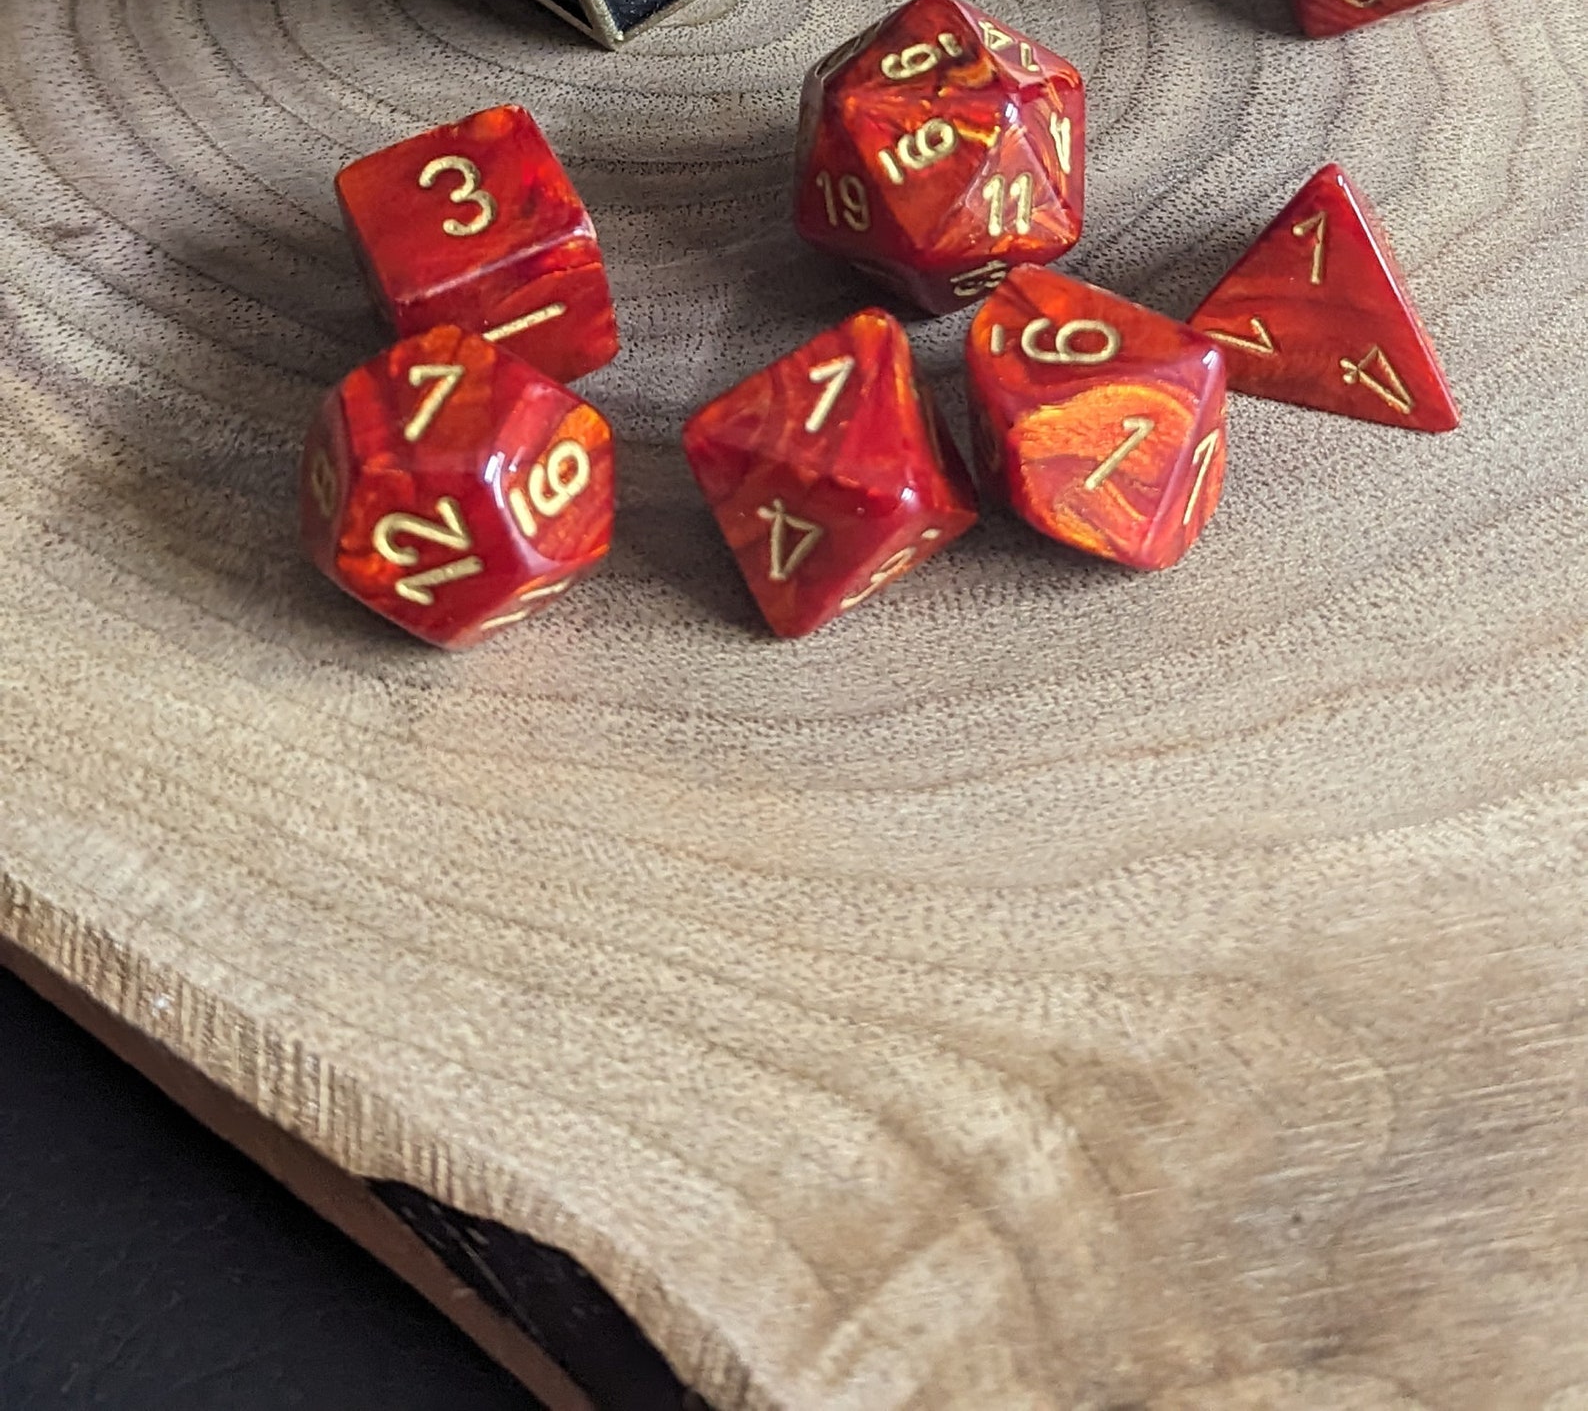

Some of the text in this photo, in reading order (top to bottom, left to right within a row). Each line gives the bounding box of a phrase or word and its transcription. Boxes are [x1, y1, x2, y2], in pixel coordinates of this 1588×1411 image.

[418, 155, 498, 238] 3
[816, 170, 872, 232] 19
[983, 171, 1034, 237] 11
[1291, 210, 1327, 286] 1
[1339, 343, 1414, 416] 4
[372, 495, 484, 607] 12
[756, 497, 825, 581] 4
